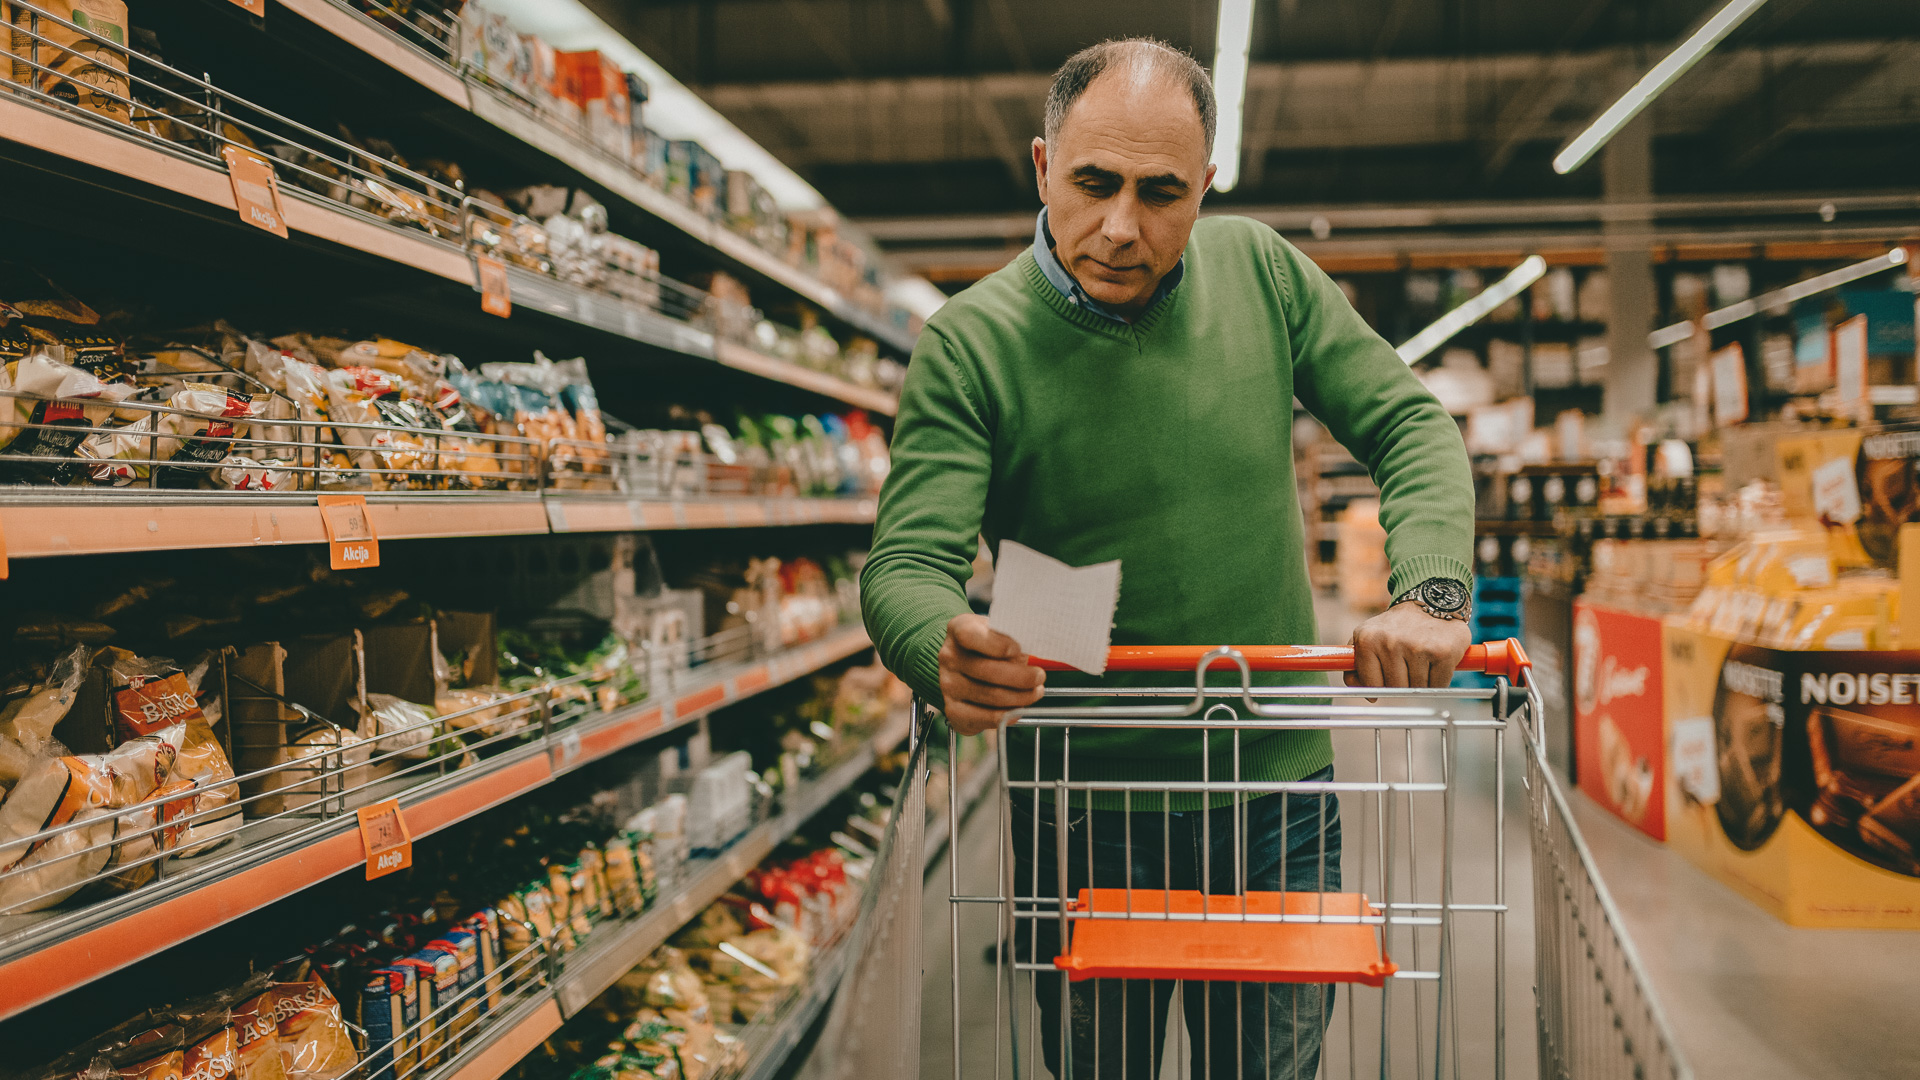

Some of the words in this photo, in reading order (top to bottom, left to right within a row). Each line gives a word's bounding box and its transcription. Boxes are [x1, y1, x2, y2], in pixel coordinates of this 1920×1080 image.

[88, 20, 111, 38] Griz
[251, 206, 277, 229] Akcija
[343, 546, 369, 563] Akcija
[129, 678, 145, 689] abc
[377, 851, 403, 871] Akcija
